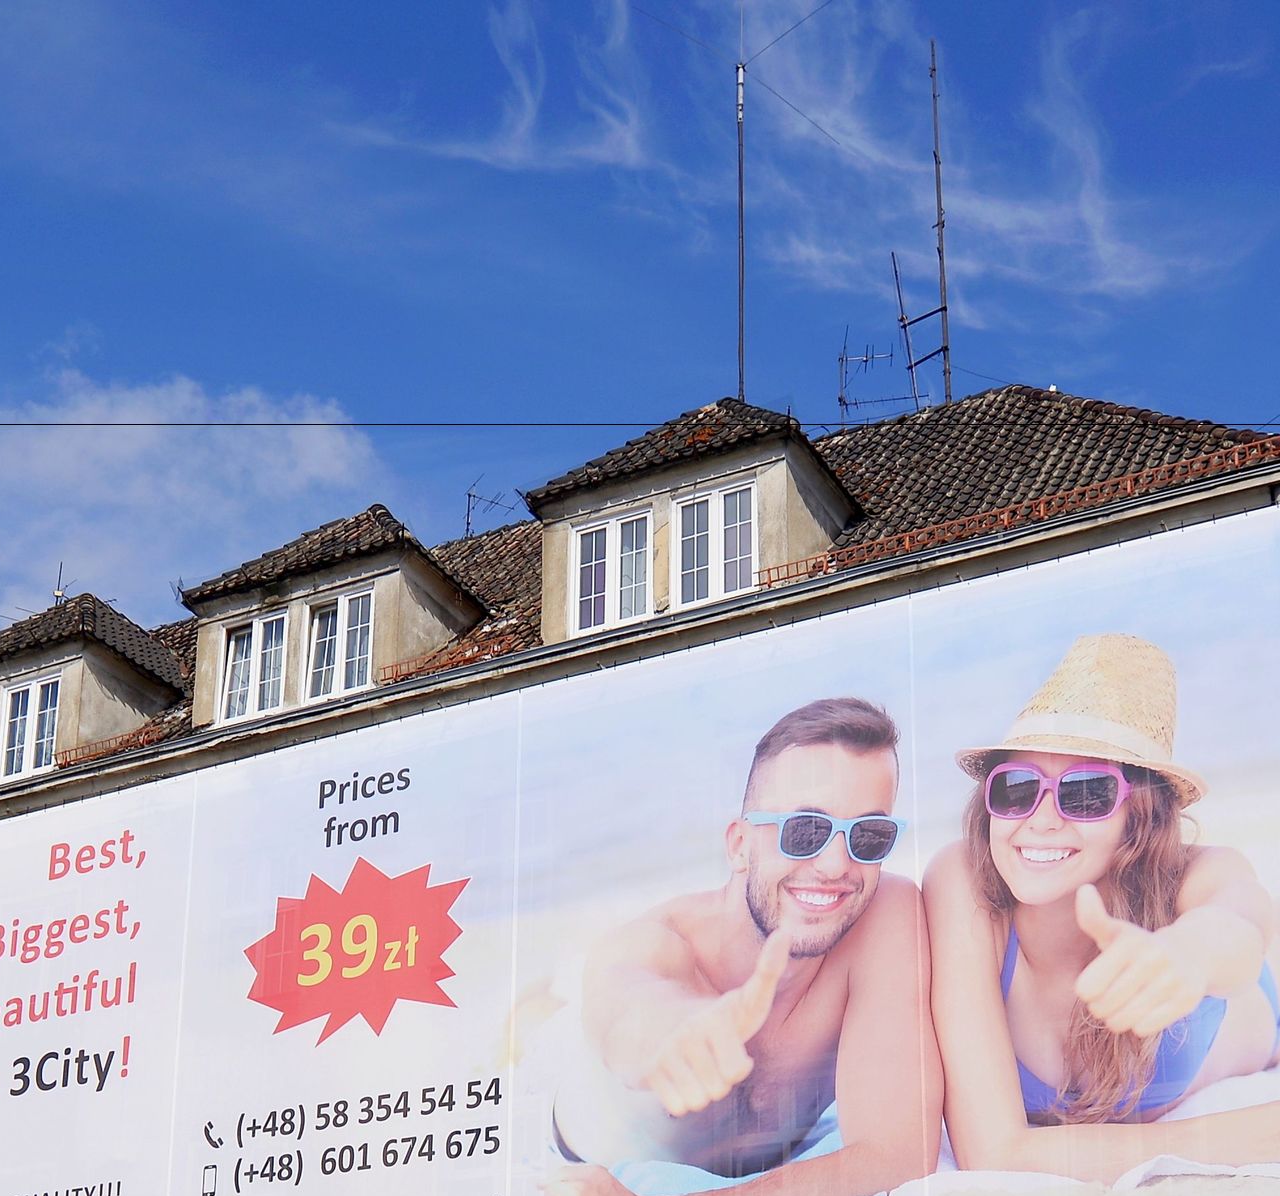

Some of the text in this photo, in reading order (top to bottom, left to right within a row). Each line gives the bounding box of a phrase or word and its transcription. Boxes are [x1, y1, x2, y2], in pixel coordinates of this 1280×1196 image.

[318, 764, 412, 809] Prices
[48, 829, 148, 881] Best,
[323, 809, 400, 848] from
[9, 1036, 132, 1098] 3City!
[235, 1077, 503, 1148] (+48) 58 354 54 54
[232, 1125, 501, 1195] (+48) 601 674 675
